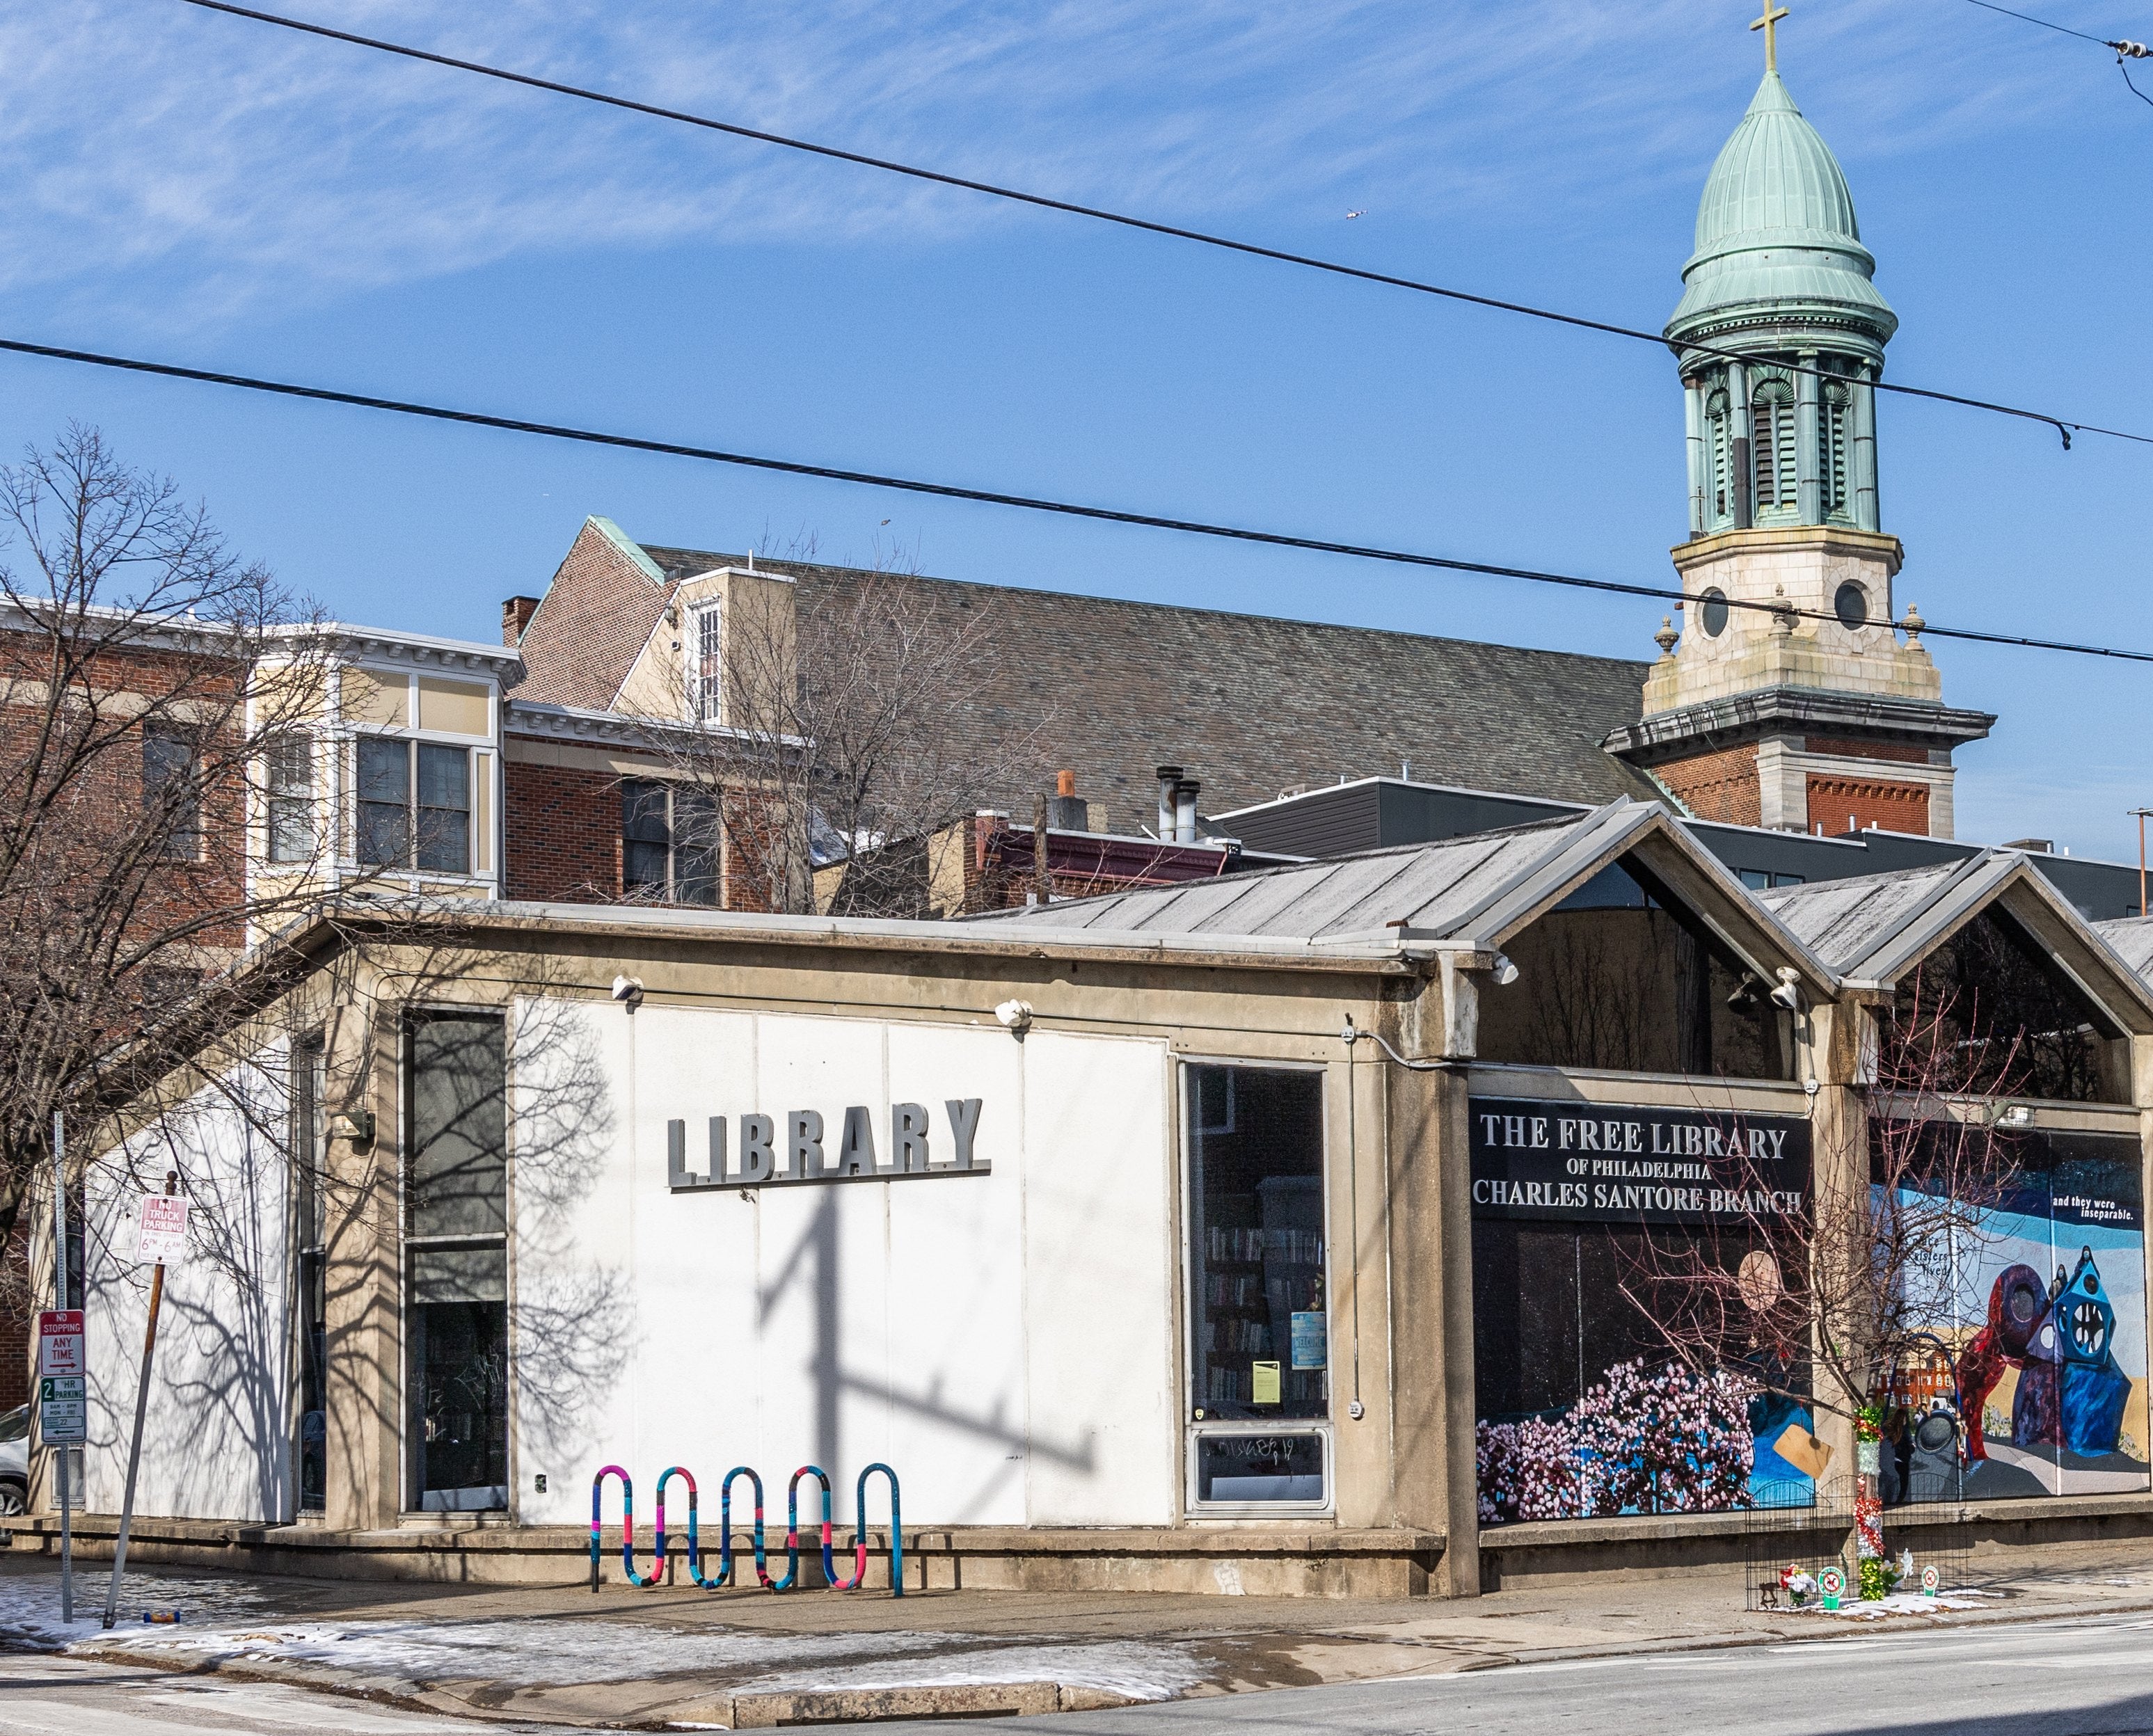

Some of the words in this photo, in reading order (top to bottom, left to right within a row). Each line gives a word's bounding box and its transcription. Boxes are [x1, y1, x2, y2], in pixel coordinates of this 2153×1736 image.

[667, 1098, 983, 1186] LIBRARY
[1480, 1114, 1549, 1148] THE
[1557, 1118, 1643, 1153] FREE
[1650, 1123, 1788, 1160] LIBRARY
[1566, 1158, 1589, 1176] OF
[1591, 1159, 1713, 1180] PHILADELPHIA
[1472, 1179, 1588, 1208] CHARLES
[1594, 1184, 1705, 1211] SANTORE
[1708, 1188, 1802, 1214] BRANCH
[2053, 1195, 2069, 1207] and
[2072, 1196, 2092, 1209] they
[2094, 1200, 2115, 1209] were
[158, 1199, 172, 1210] NO
[150, 1209, 180, 1221] TRUCK
[2081, 1207, 2134, 1221] inseparable.
[143, 1219, 183, 1232] PARKING
[56, 1313, 67, 1322] NO
[43, 1323, 81, 1333] STOPPING
[52, 1337, 73, 1348] ANY
[1294, 1336, 1322, 1348] WELCOME
[51, 1348, 74, 1360] TIME
[43, 1382, 52, 1399] 2
[64, 1379, 76, 1388] HR
[56, 1389, 84, 1399] PARKING
